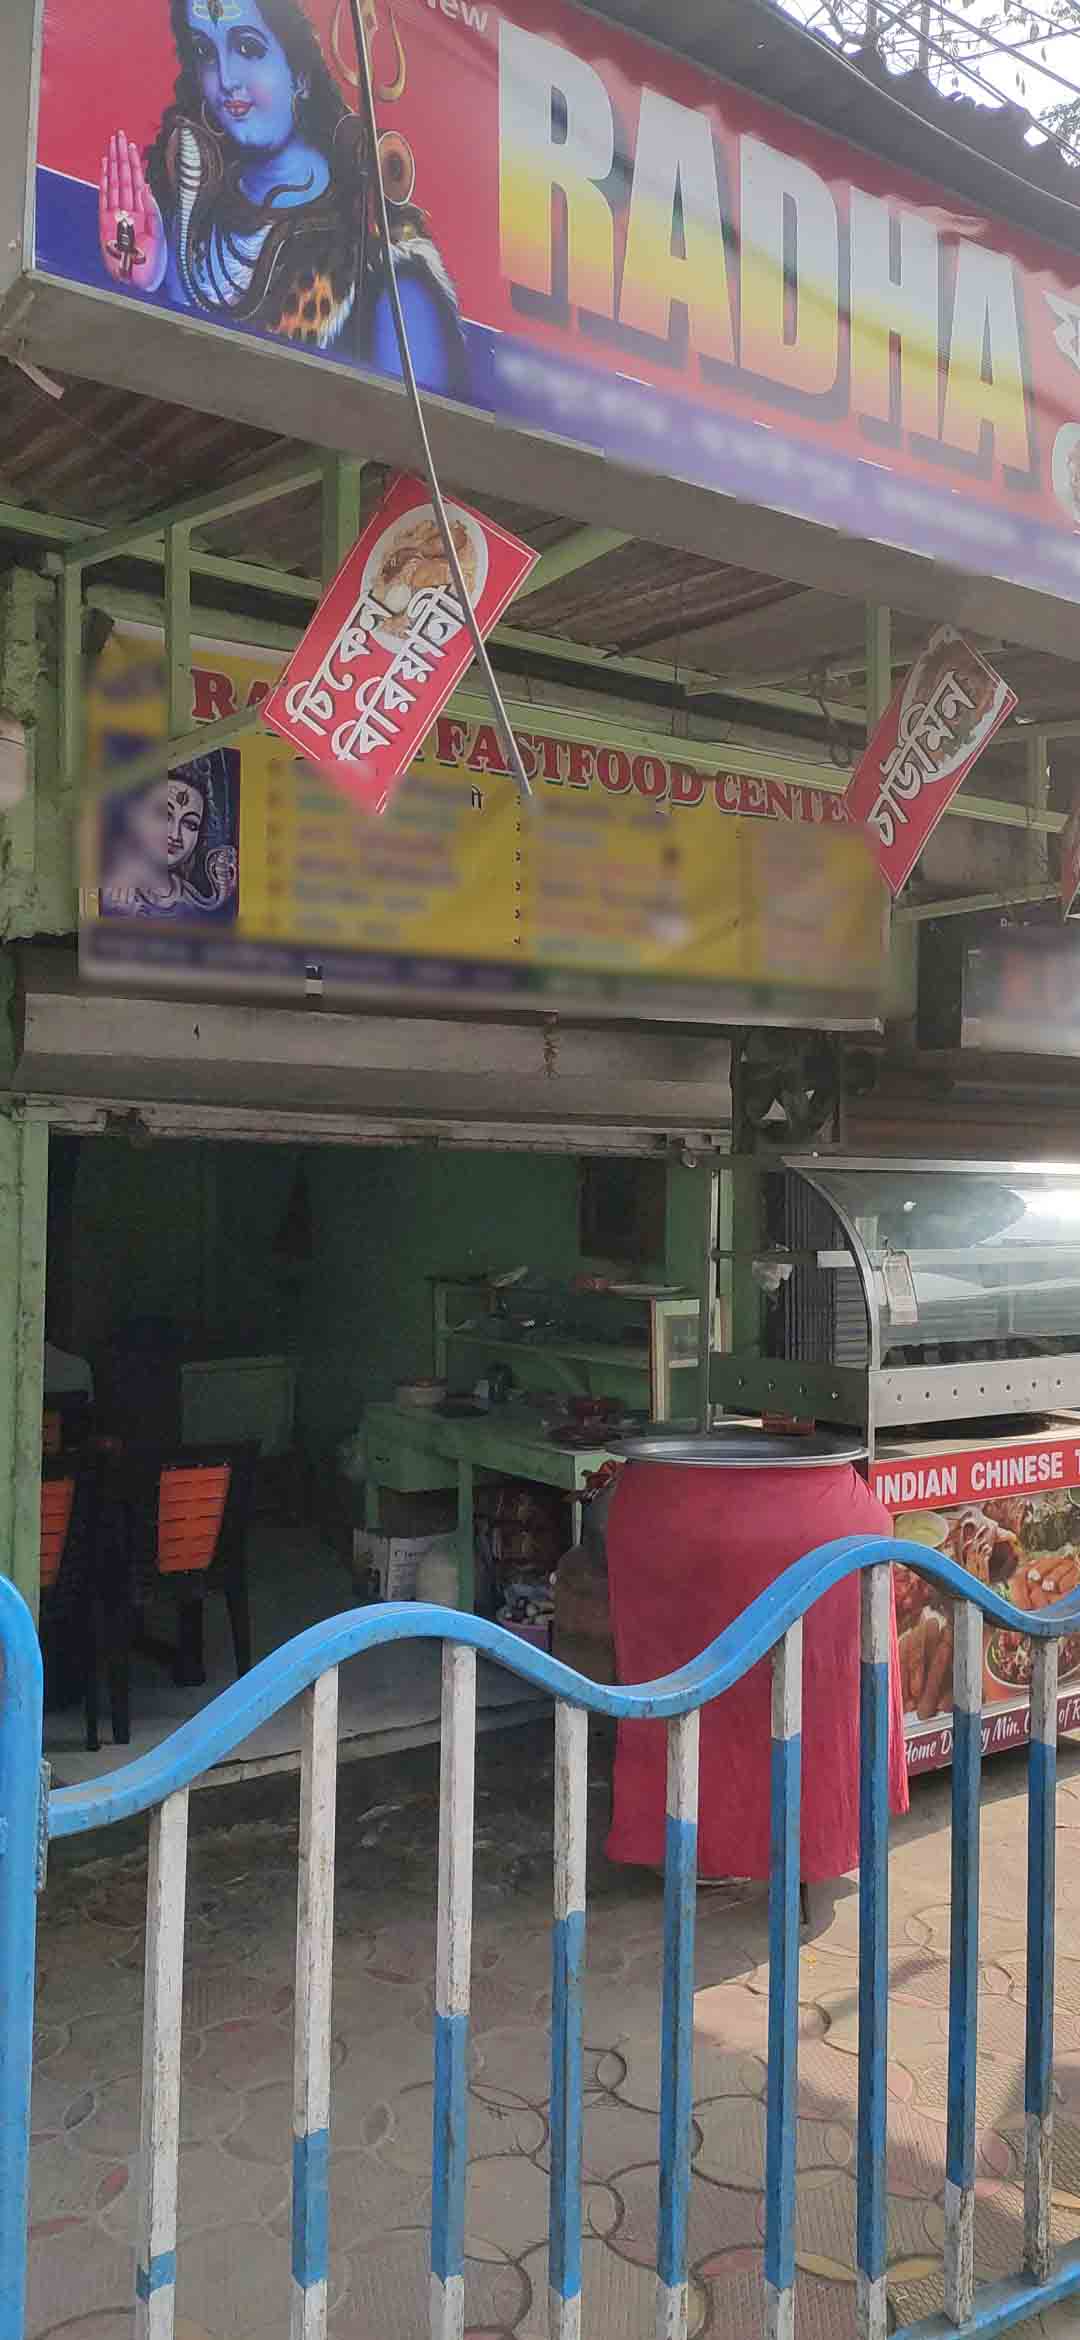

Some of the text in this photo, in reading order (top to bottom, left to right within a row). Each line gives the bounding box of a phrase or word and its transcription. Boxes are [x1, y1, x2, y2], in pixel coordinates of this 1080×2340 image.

[498, 14, 1036, 476] RADHA
[285, 589, 392, 736] চিকেন
[434, 716, 854, 825] FASTFOOD CENTE
[867, 671, 976, 847] চাউমিন
[875, 1465, 958, 1505] INDIAN
[970, 1451, 1064, 1491] CHINESE
